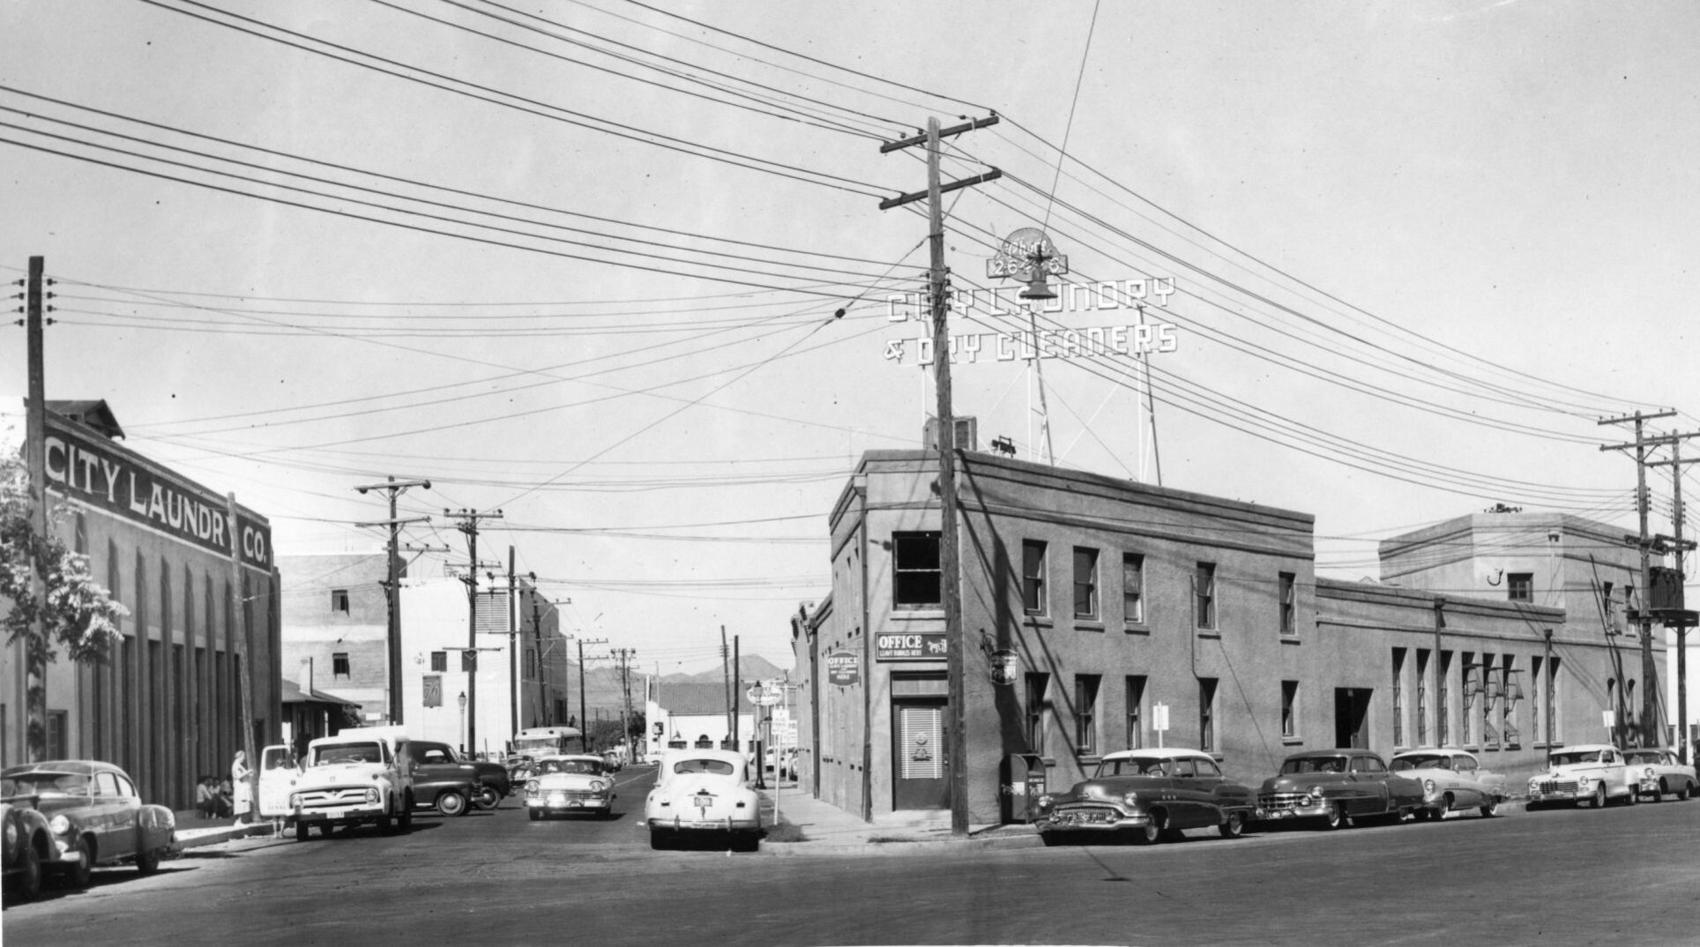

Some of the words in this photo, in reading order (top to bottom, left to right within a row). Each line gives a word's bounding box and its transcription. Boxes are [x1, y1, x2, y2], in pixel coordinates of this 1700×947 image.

[887, 289, 975, 322] CIY
[884, 339, 906, 361] &
[997, 324, 1178, 361] CLEANERS
[44, 436, 121, 503] CITY
[243, 525, 267, 563] CO.
[879, 636, 923, 649] OFFICE
